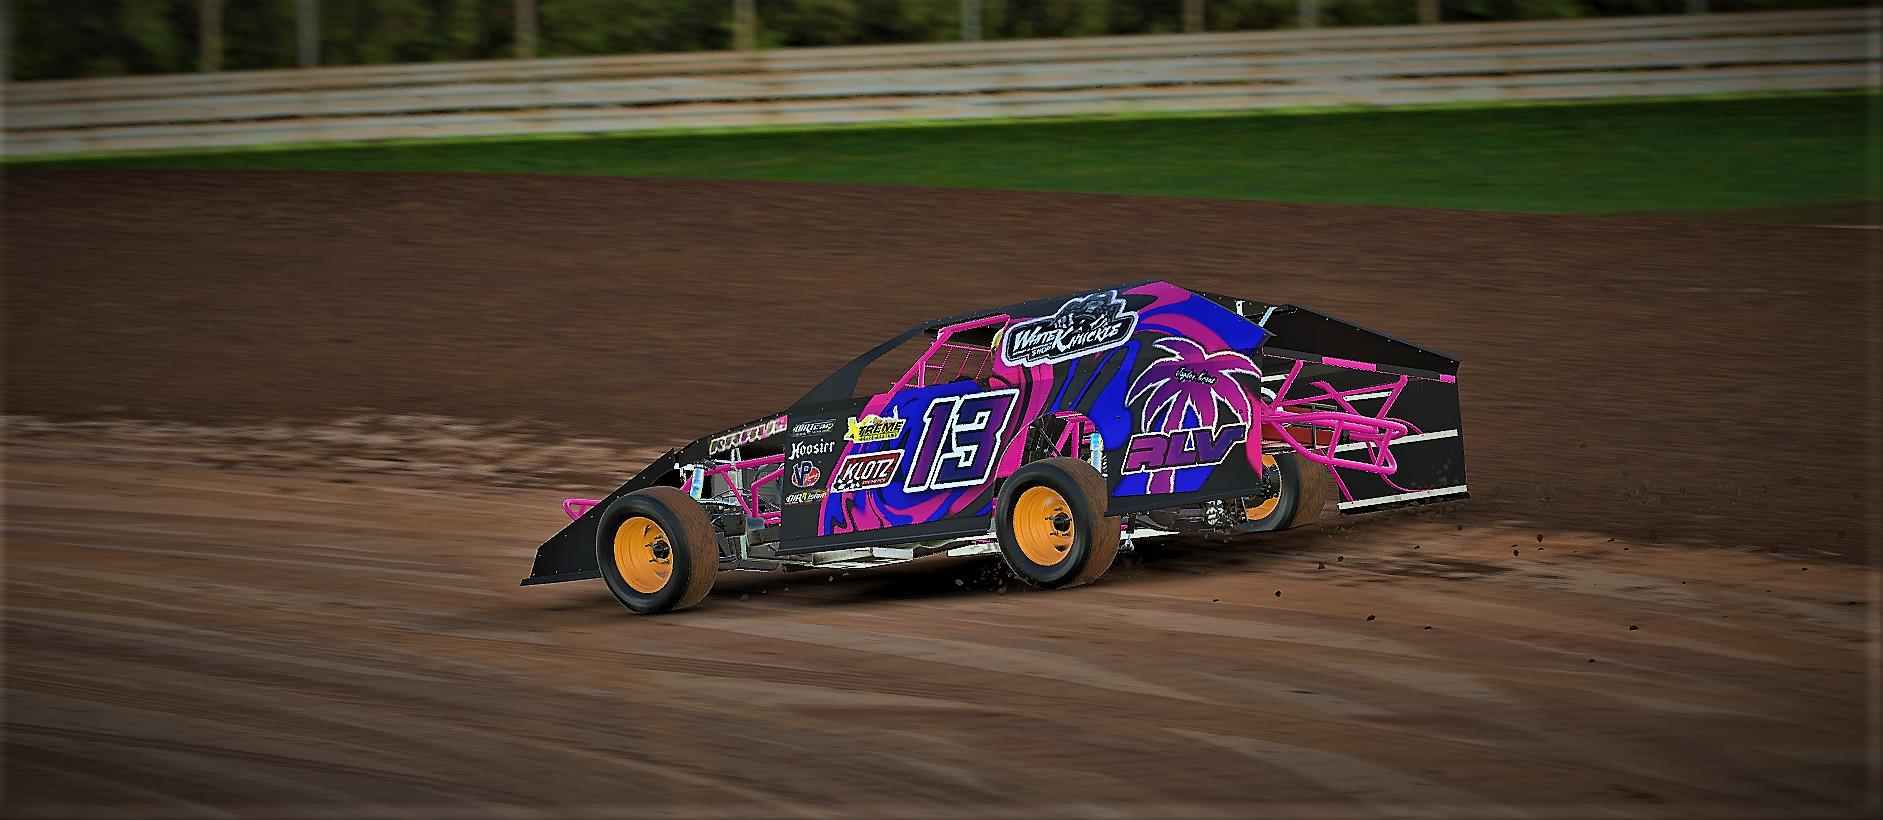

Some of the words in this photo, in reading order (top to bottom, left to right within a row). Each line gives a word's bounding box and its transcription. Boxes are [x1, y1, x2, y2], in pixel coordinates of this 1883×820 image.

[1012, 326, 1056, 352] WHITE
[1053, 321, 1122, 353] KNUCKLE
[845, 417, 903, 442] XTREME
[903, 389, 1020, 494] 13
[788, 438, 836, 460] Hoosier
[1121, 423, 1248, 475] RLV
[793, 461, 814, 487] VP
[842, 458, 896, 480] KLOTZ
